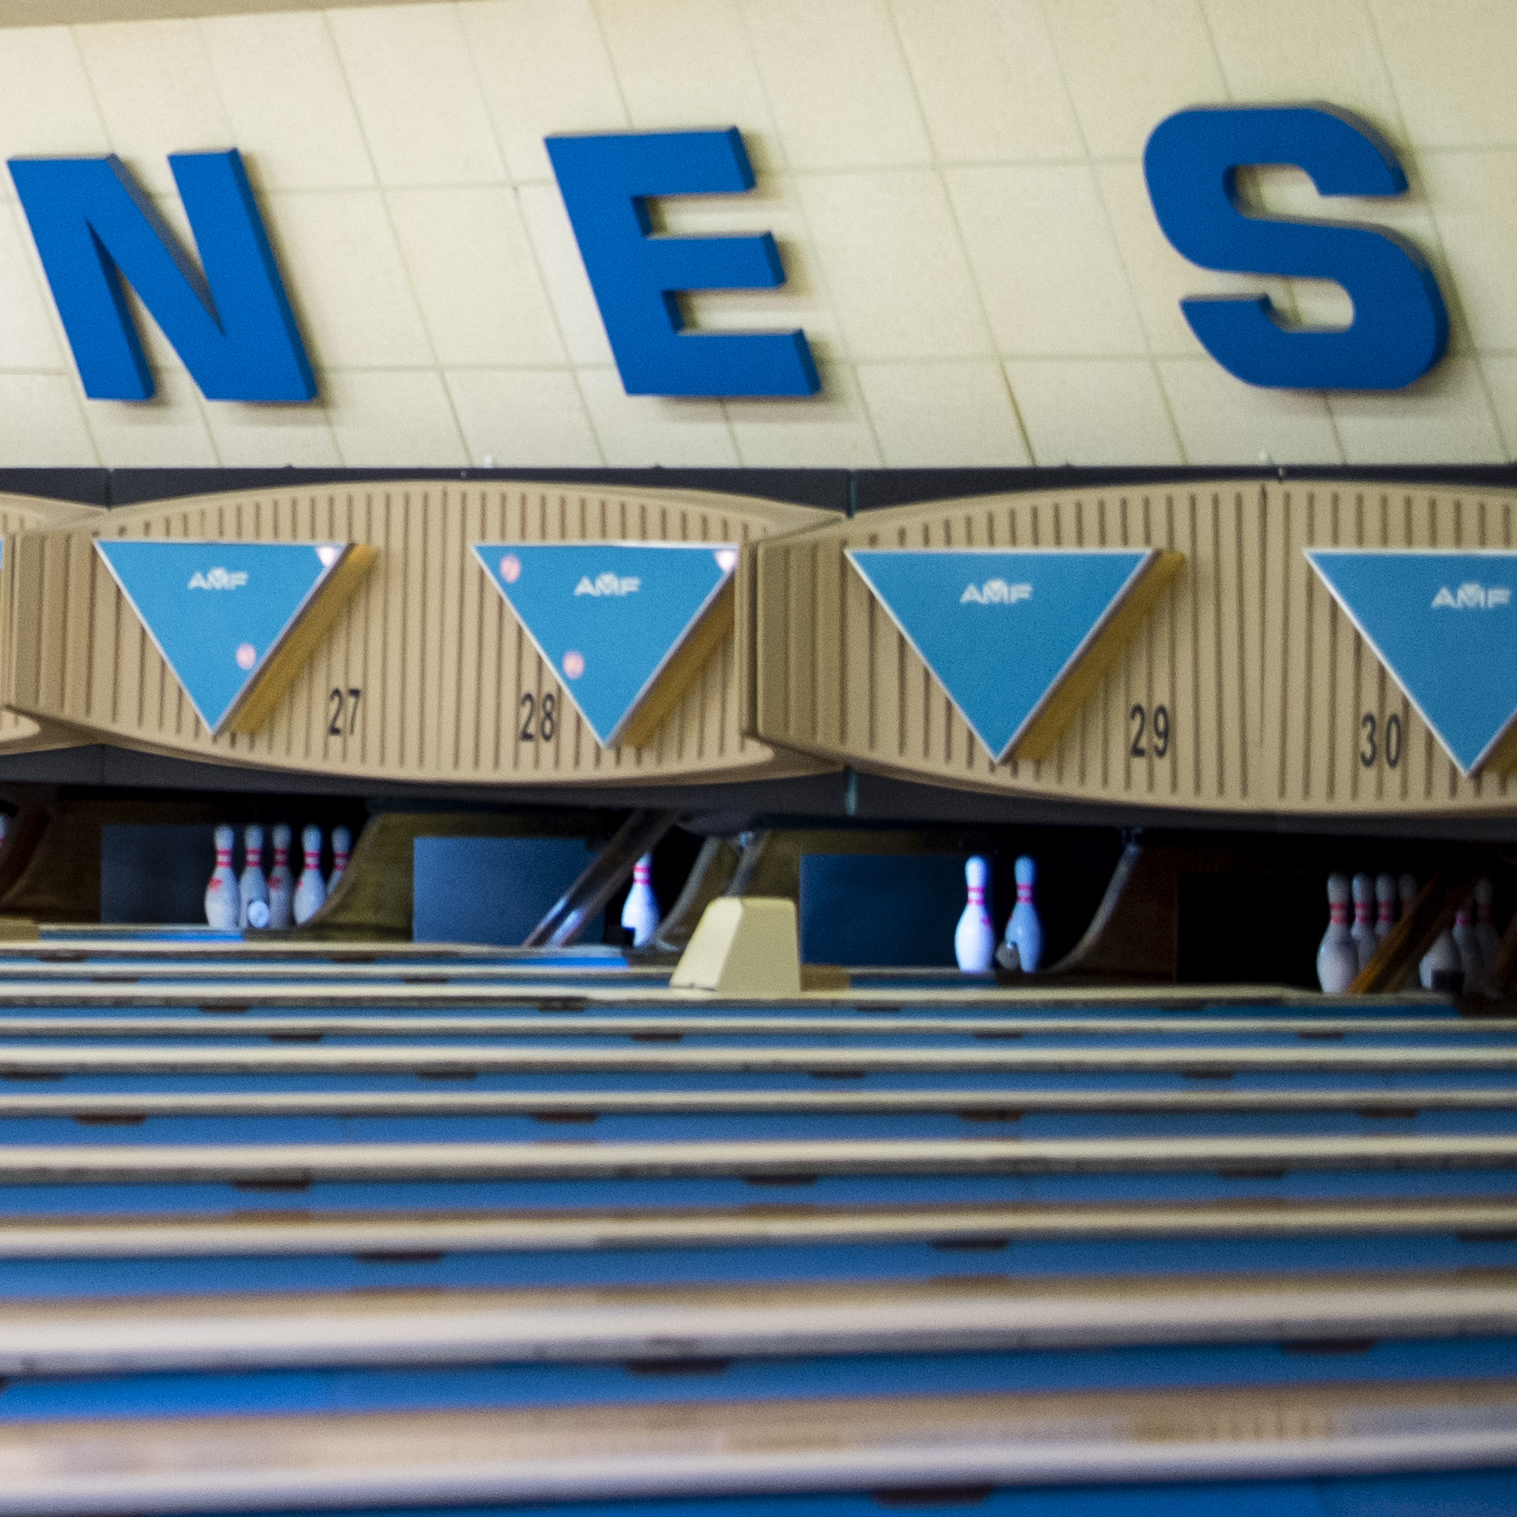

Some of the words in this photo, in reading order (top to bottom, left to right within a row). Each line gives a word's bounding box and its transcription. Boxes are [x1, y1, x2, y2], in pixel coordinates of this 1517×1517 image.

[188, 567, 248, 590] AMF
[574, 572, 641, 597] AMF
[960, 578, 1033, 605] AMF
[1432, 581, 1511, 610] AMF
[328, 688, 361, 735] 27
[519, 692, 556, 741] 28
[1129, 704, 1169, 758] 29
[1361, 713, 1402, 767] 30
